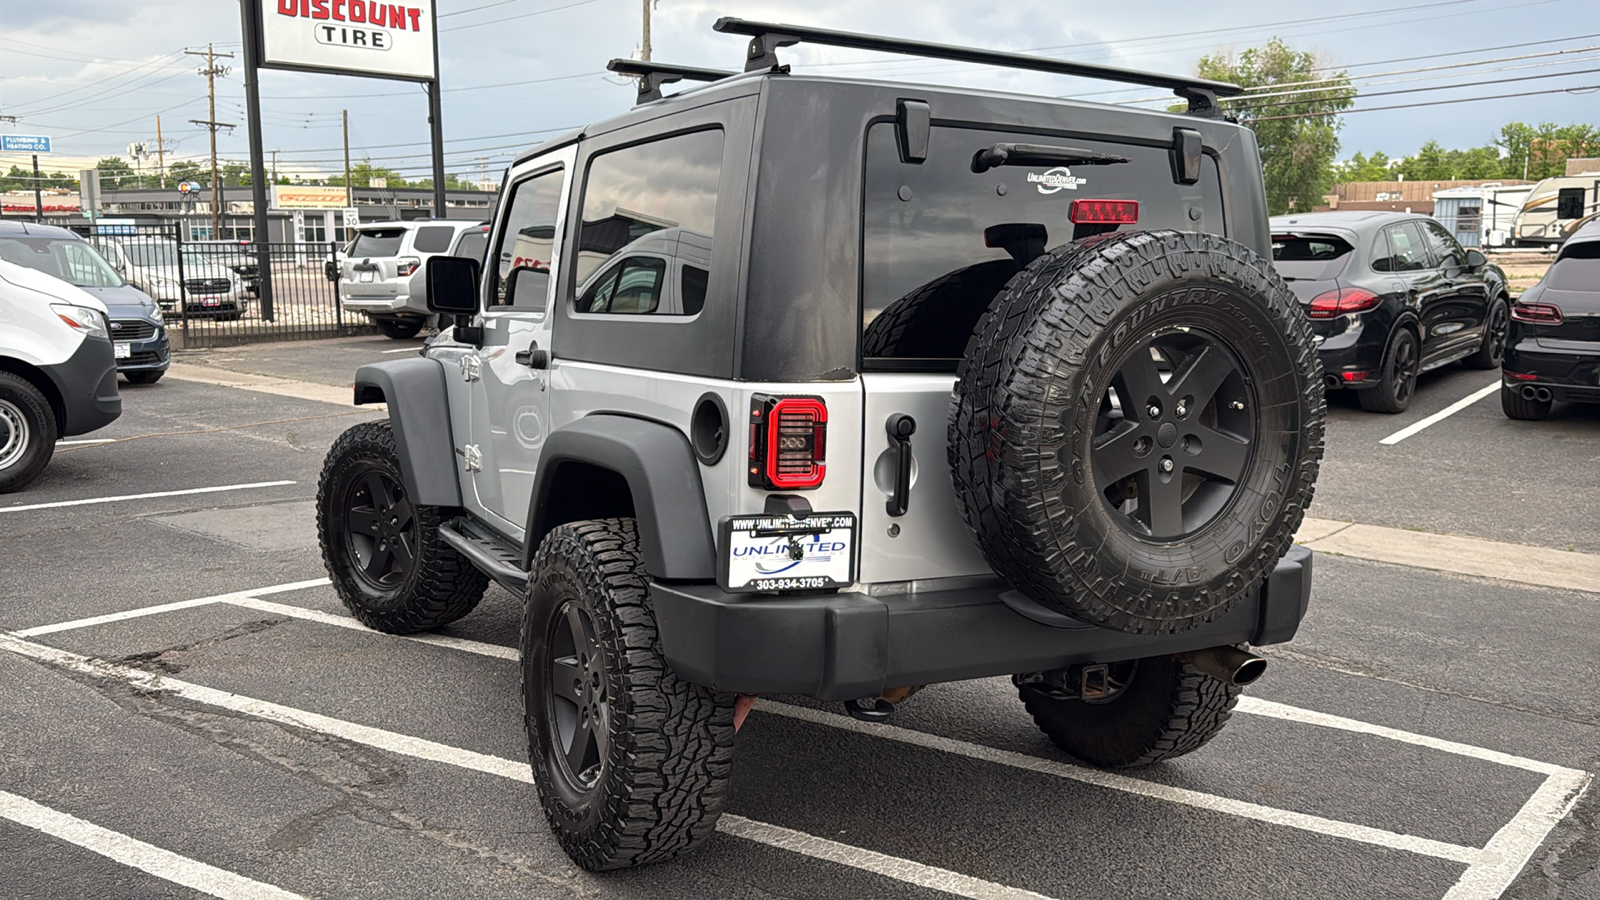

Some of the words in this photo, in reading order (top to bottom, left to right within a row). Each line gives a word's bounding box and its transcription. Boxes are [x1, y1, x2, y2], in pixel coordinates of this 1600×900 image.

[277, 0, 421, 32] DISCOUNT
[321, 25, 384, 48] TIRE
[5, 136, 39, 144] PLUMBING
[346, 217, 358, 226] 30
[1100, 286, 1229, 367] COUNTRY
[1225, 462, 1292, 564] TOYO
[732, 516, 853, 530] WWWUNLIMITEDDENVER.COM
[756, 577, 824, 591] 303-934-3705
